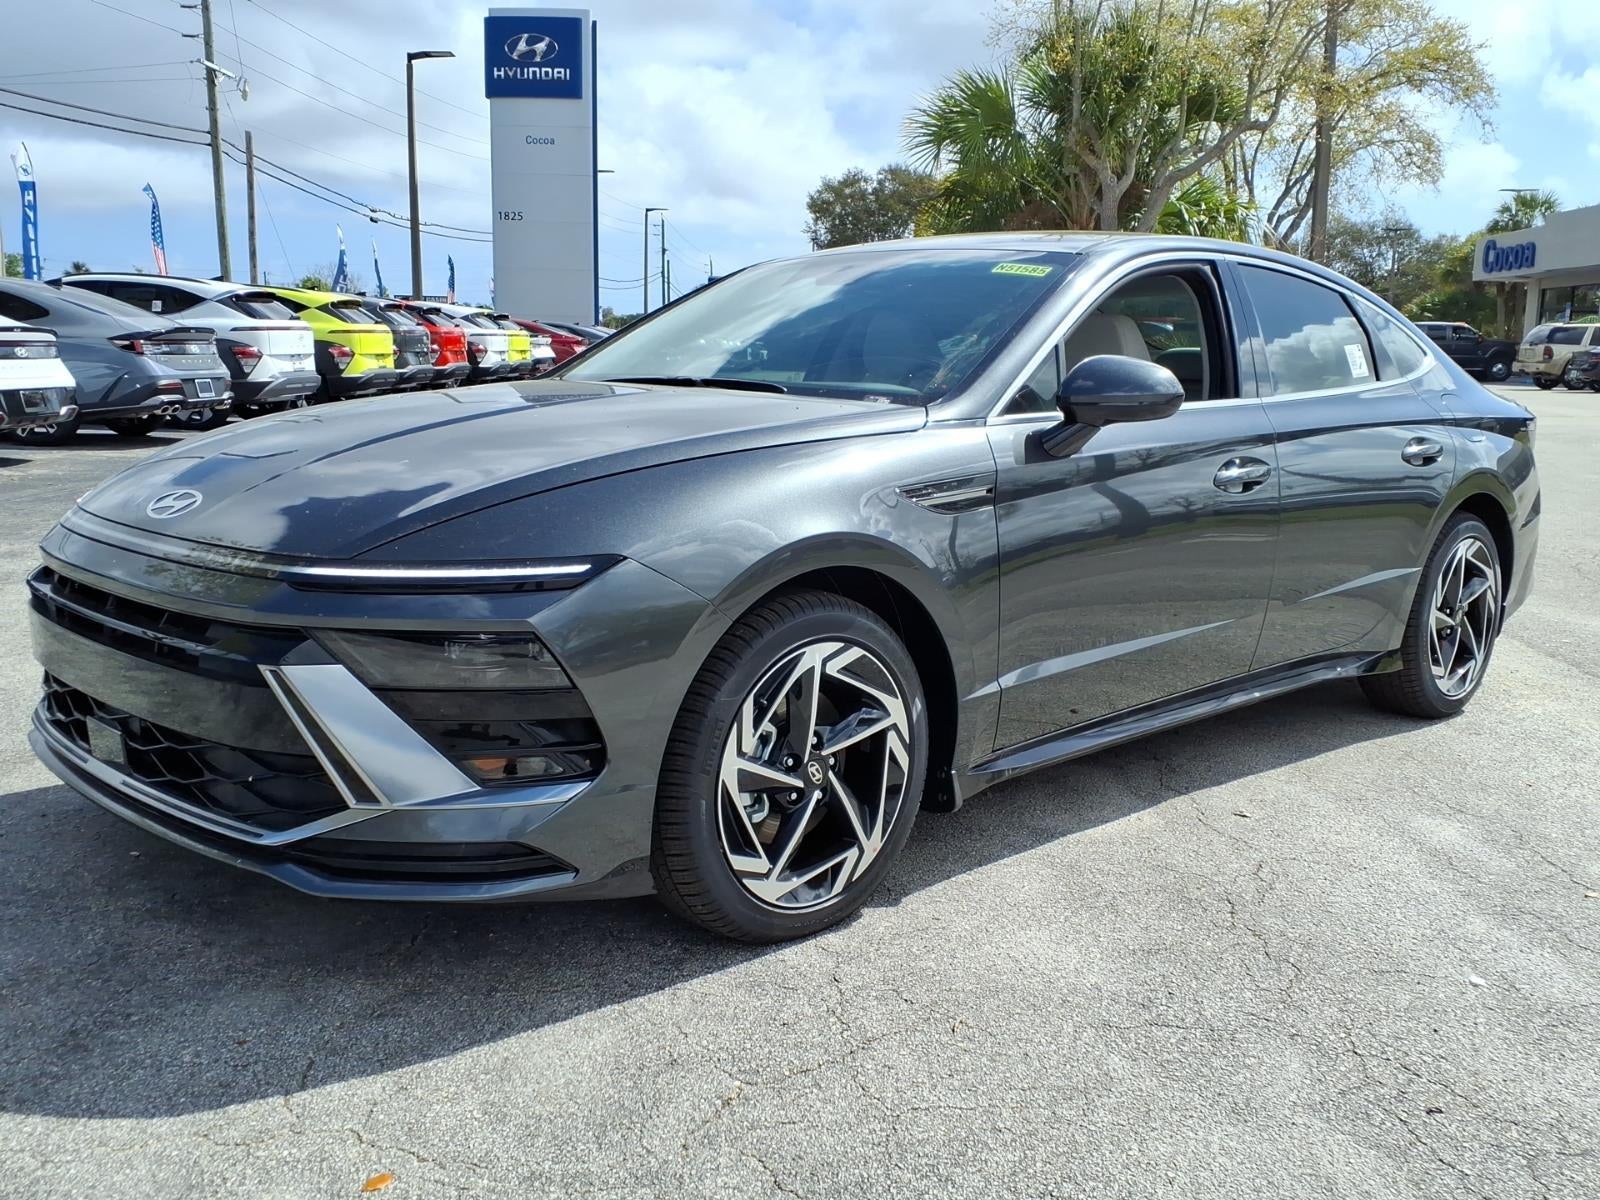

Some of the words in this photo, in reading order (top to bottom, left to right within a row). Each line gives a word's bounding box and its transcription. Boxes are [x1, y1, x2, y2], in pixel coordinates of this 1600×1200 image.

[493, 67, 570, 81] HYUNDAI
[525, 135, 555, 145] Cocoa
[497, 211, 524, 221] 1825
[1482, 240, 1536, 273] Cocoa
[995, 263, 1049, 275] N51585
